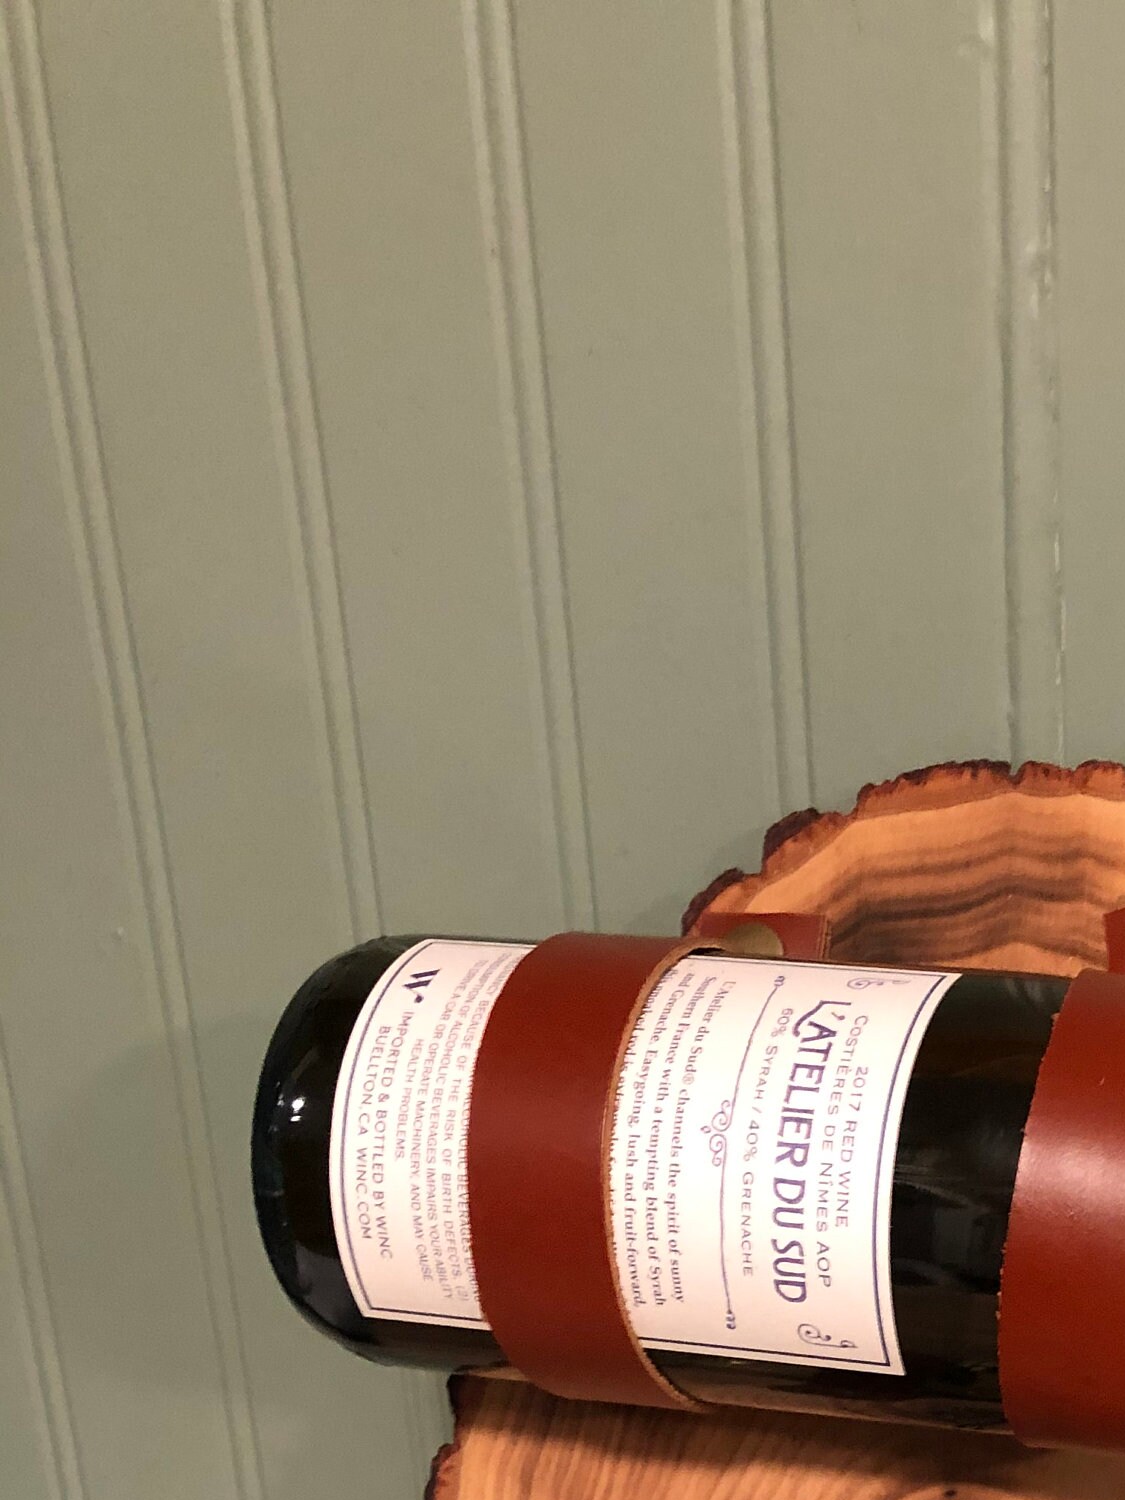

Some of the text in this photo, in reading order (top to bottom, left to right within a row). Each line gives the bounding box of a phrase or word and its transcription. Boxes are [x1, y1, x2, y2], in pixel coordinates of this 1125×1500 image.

[440, 1000, 457, 1021] CAR
[458, 1004, 471, 1018] OF
[681, 976, 717, 1019] Southern
[433, 1022, 447, 1040] OR
[461, 1000, 490, 1049] BECAUSE
[664, 1022, 690, 1064] France
[694, 1026, 710, 1042] du
[771, 1008, 794, 1037] 60%
[405, 1038, 425, 1083] HEALTH
[417, 1042, 440, 1096] OPERATE
[435, 1019, 463, 1085] ALCOHOLIC
[455, 1055, 467, 1071] OF
[448, 1078, 461, 1102] THE
[656, 1068, 672, 1102] with
[358, 1113, 371, 1136] CA
[371, 1011, 415, 1260] IMPORTED & BOTTLED BY WINC
[426, 1087, 444, 1164] BEVERAGES
[444, 1109, 457, 1142] RISK
[670, 1088, 691, 1158] channels
[743, 1119, 760, 1162] 40%
[822, 1125, 836, 1152] DE
[441, 1147, 453, 1167] OF
[626, 1133, 641, 1168] lush
[642, 1119, 663, 1192] tempting
[771, 1000, 852, 1304] L'ATELIER DU SUD
[835, 1066, 868, 1228] 2017 RED WINE
[355, 1147, 372, 1239] WINC.COM
[426, 1167, 439, 1221] IMPAIRS
[441, 1173, 453, 1214] BIRTH
[624, 1172, 637, 1202] and
[668, 1163, 681, 1188] the
[410, 1183, 422, 1212] AND
[664, 1192, 680, 1234] spirit
[412, 1215, 425, 1240] MAY
[646, 1196, 658, 1242] blend
[429, 1223, 443, 1257] YOUR
[648, 1246, 661, 1264] of
[668, 1239, 682, 1256] of
[415, 1243, 435, 1282] CAUSE
[435, 1255, 454, 1299] ABILITY
[670, 1258, 685, 1303] sunny
[816, 1241, 832, 1288] AOP
[649, 1266, 667, 1307] Syrah
